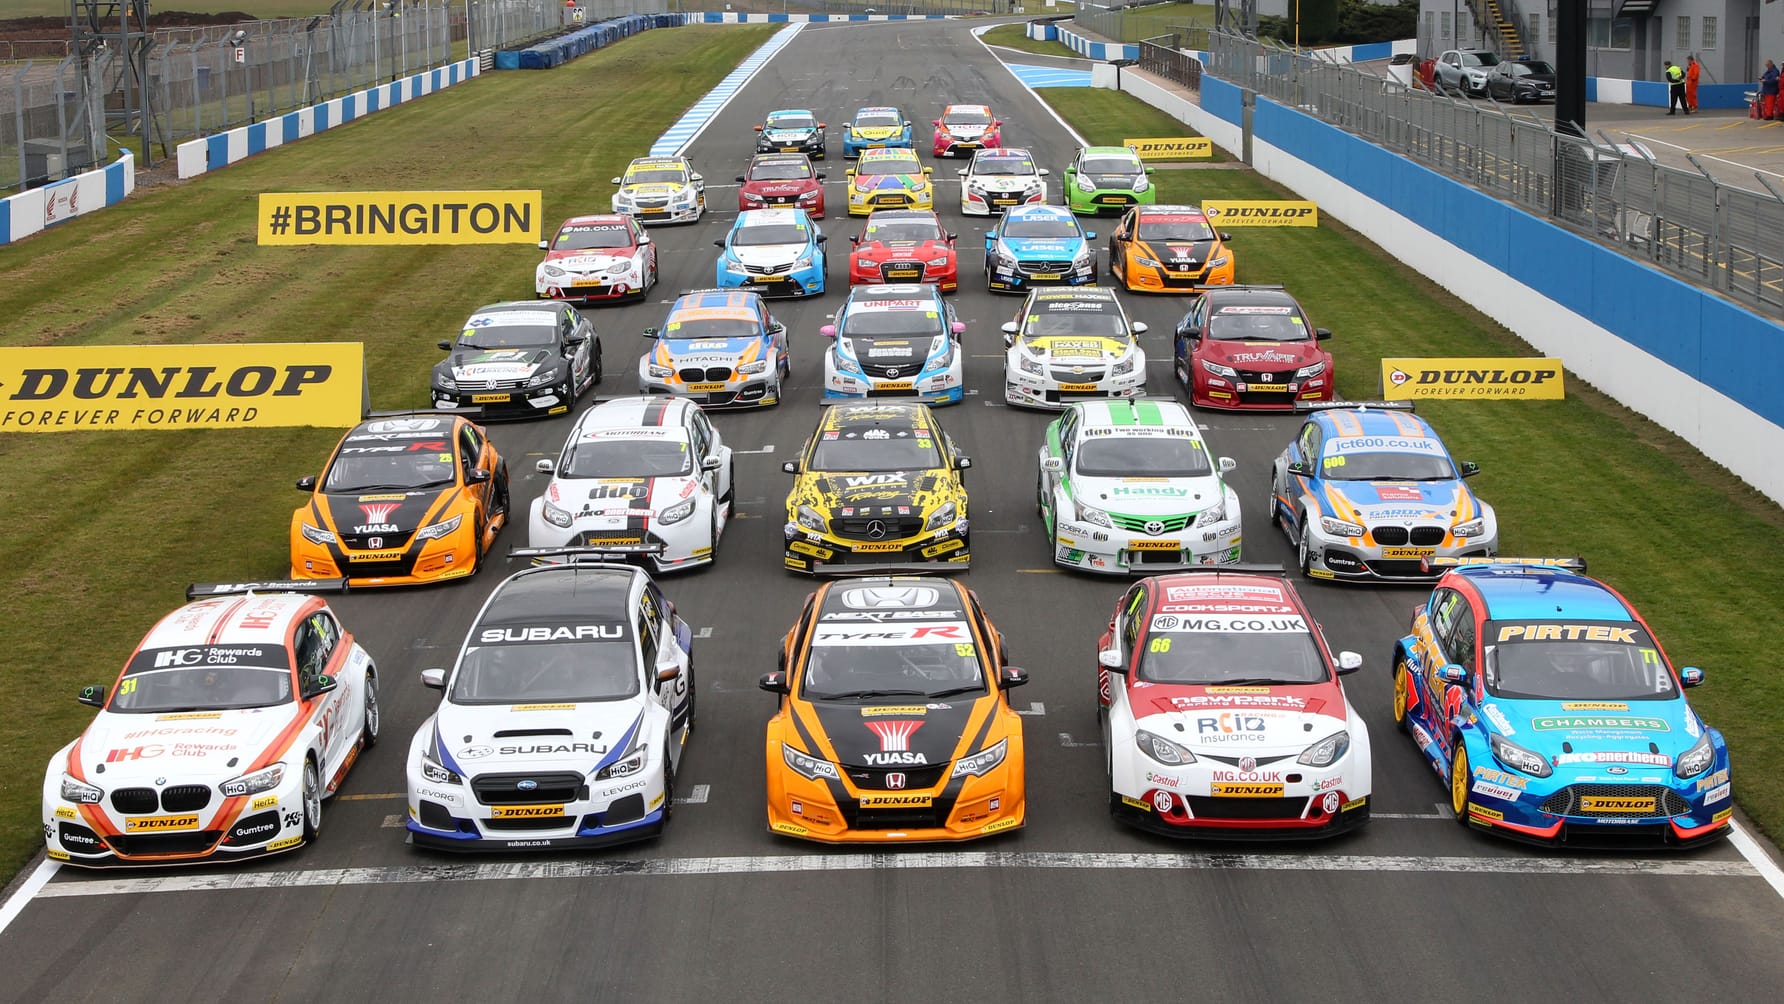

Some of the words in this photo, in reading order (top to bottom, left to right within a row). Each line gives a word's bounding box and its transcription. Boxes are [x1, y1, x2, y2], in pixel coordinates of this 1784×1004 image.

[237, 49, 243, 60] F
[1142, 143, 1208, 152] DUNLOP
[1223, 208, 1313, 217] DUNLOP
[270, 203, 531, 235] #BRINGITON
[864, 300, 921, 308] UNIPART
[1416, 370, 1556, 384] DUNLOP
[9, 365, 332, 401] DUNLOP
[1470, 387, 1526, 395] FORWARD
[2, 410, 120, 426] FOREVER
[132, 407, 258, 424] FORWARD
[407, 441, 448, 451] R
[680, 443, 687, 452] 7
[917, 439, 932, 449] 33
[1335, 438, 1433, 452] jct600.co.uk
[1323, 456, 1346, 469] 600
[846, 474, 907, 486] WIX
[589, 486, 649, 500] duo
[1113, 487, 1188, 496] Handy
[354, 524, 399, 534] YUASA
[1058, 523, 1088, 536] COBRA
[1093, 531, 1108, 542] duo
[1203, 532, 1217, 542] duo
[1183, 618, 1308, 631] MG.CO.UK
[481, 625, 623, 642] SUBARU
[818, 632, 906, 640] TYPE
[912, 626, 964, 638] R
[1498, 625, 1638, 643] PIRTEK
[955, 644, 976, 657] 52
[1151, 639, 1171, 652] 66
[154, 649, 202, 667] IHG
[209, 647, 262, 657] Rewards
[207, 654, 238, 664] Club
[1640, 649, 1659, 665] 77
[120, 678, 138, 694] 31
[1171, 695, 1304, 704] newpark
[1540, 717, 1668, 731] CHAMBERS
[124, 728, 238, 739] #IHGracing
[1200, 733, 1265, 743] Insurance
[106, 743, 165, 762] IHG
[175, 743, 237, 752] Rewards
[172, 749, 207, 758] Club
[499, 743, 607, 755] SUBARU
[864, 752, 927, 765] YUASA
[1558, 754, 1596, 765] IKO
[1597, 752, 1670, 765] enertherm
[611, 765, 627, 776] HiQ
[815, 764, 831, 773] HiQ
[959, 761, 976, 770] HiQ
[1522, 762, 1540, 773] HiQ
[1687, 764, 1701, 774] HiQ
[433, 769, 448, 781] HiQ
[1152, 774, 1179, 787] Castrol
[1212, 771, 1281, 782] MG.CO.UK
[1473, 767, 1531, 790] PIRTEK
[1697, 769, 1728, 792] PIRTEK
[1321, 775, 1343, 790] Castrol
[227, 784, 246, 795] HiQ
[416, 788, 454, 801] LEVORG
[602, 781, 646, 797] LEVORG
[1225, 786, 1282, 794] DUNLOP
[81, 791, 98, 801] HiQ
[872, 796, 931, 805] DUNLOP
[1155, 793, 1171, 810] MG
[254, 797, 275, 808] Hertz
[1324, 793, 1338, 811] MG
[1594, 799, 1654, 809] DUNLOP
[56, 808, 74, 818] Hertz
[504, 807, 563, 817] DUNLOP
[1474, 807, 1502, 817] DUNLOP
[138, 817, 197, 828] DUNLOP
[987, 819, 1015, 830] DUNLOP
[236, 822, 274, 836] Gumtree
[779, 824, 807, 833] DUNLOP
[63, 833, 94, 845] Gumtree
[507, 839, 550, 847] subaru.co.uk
